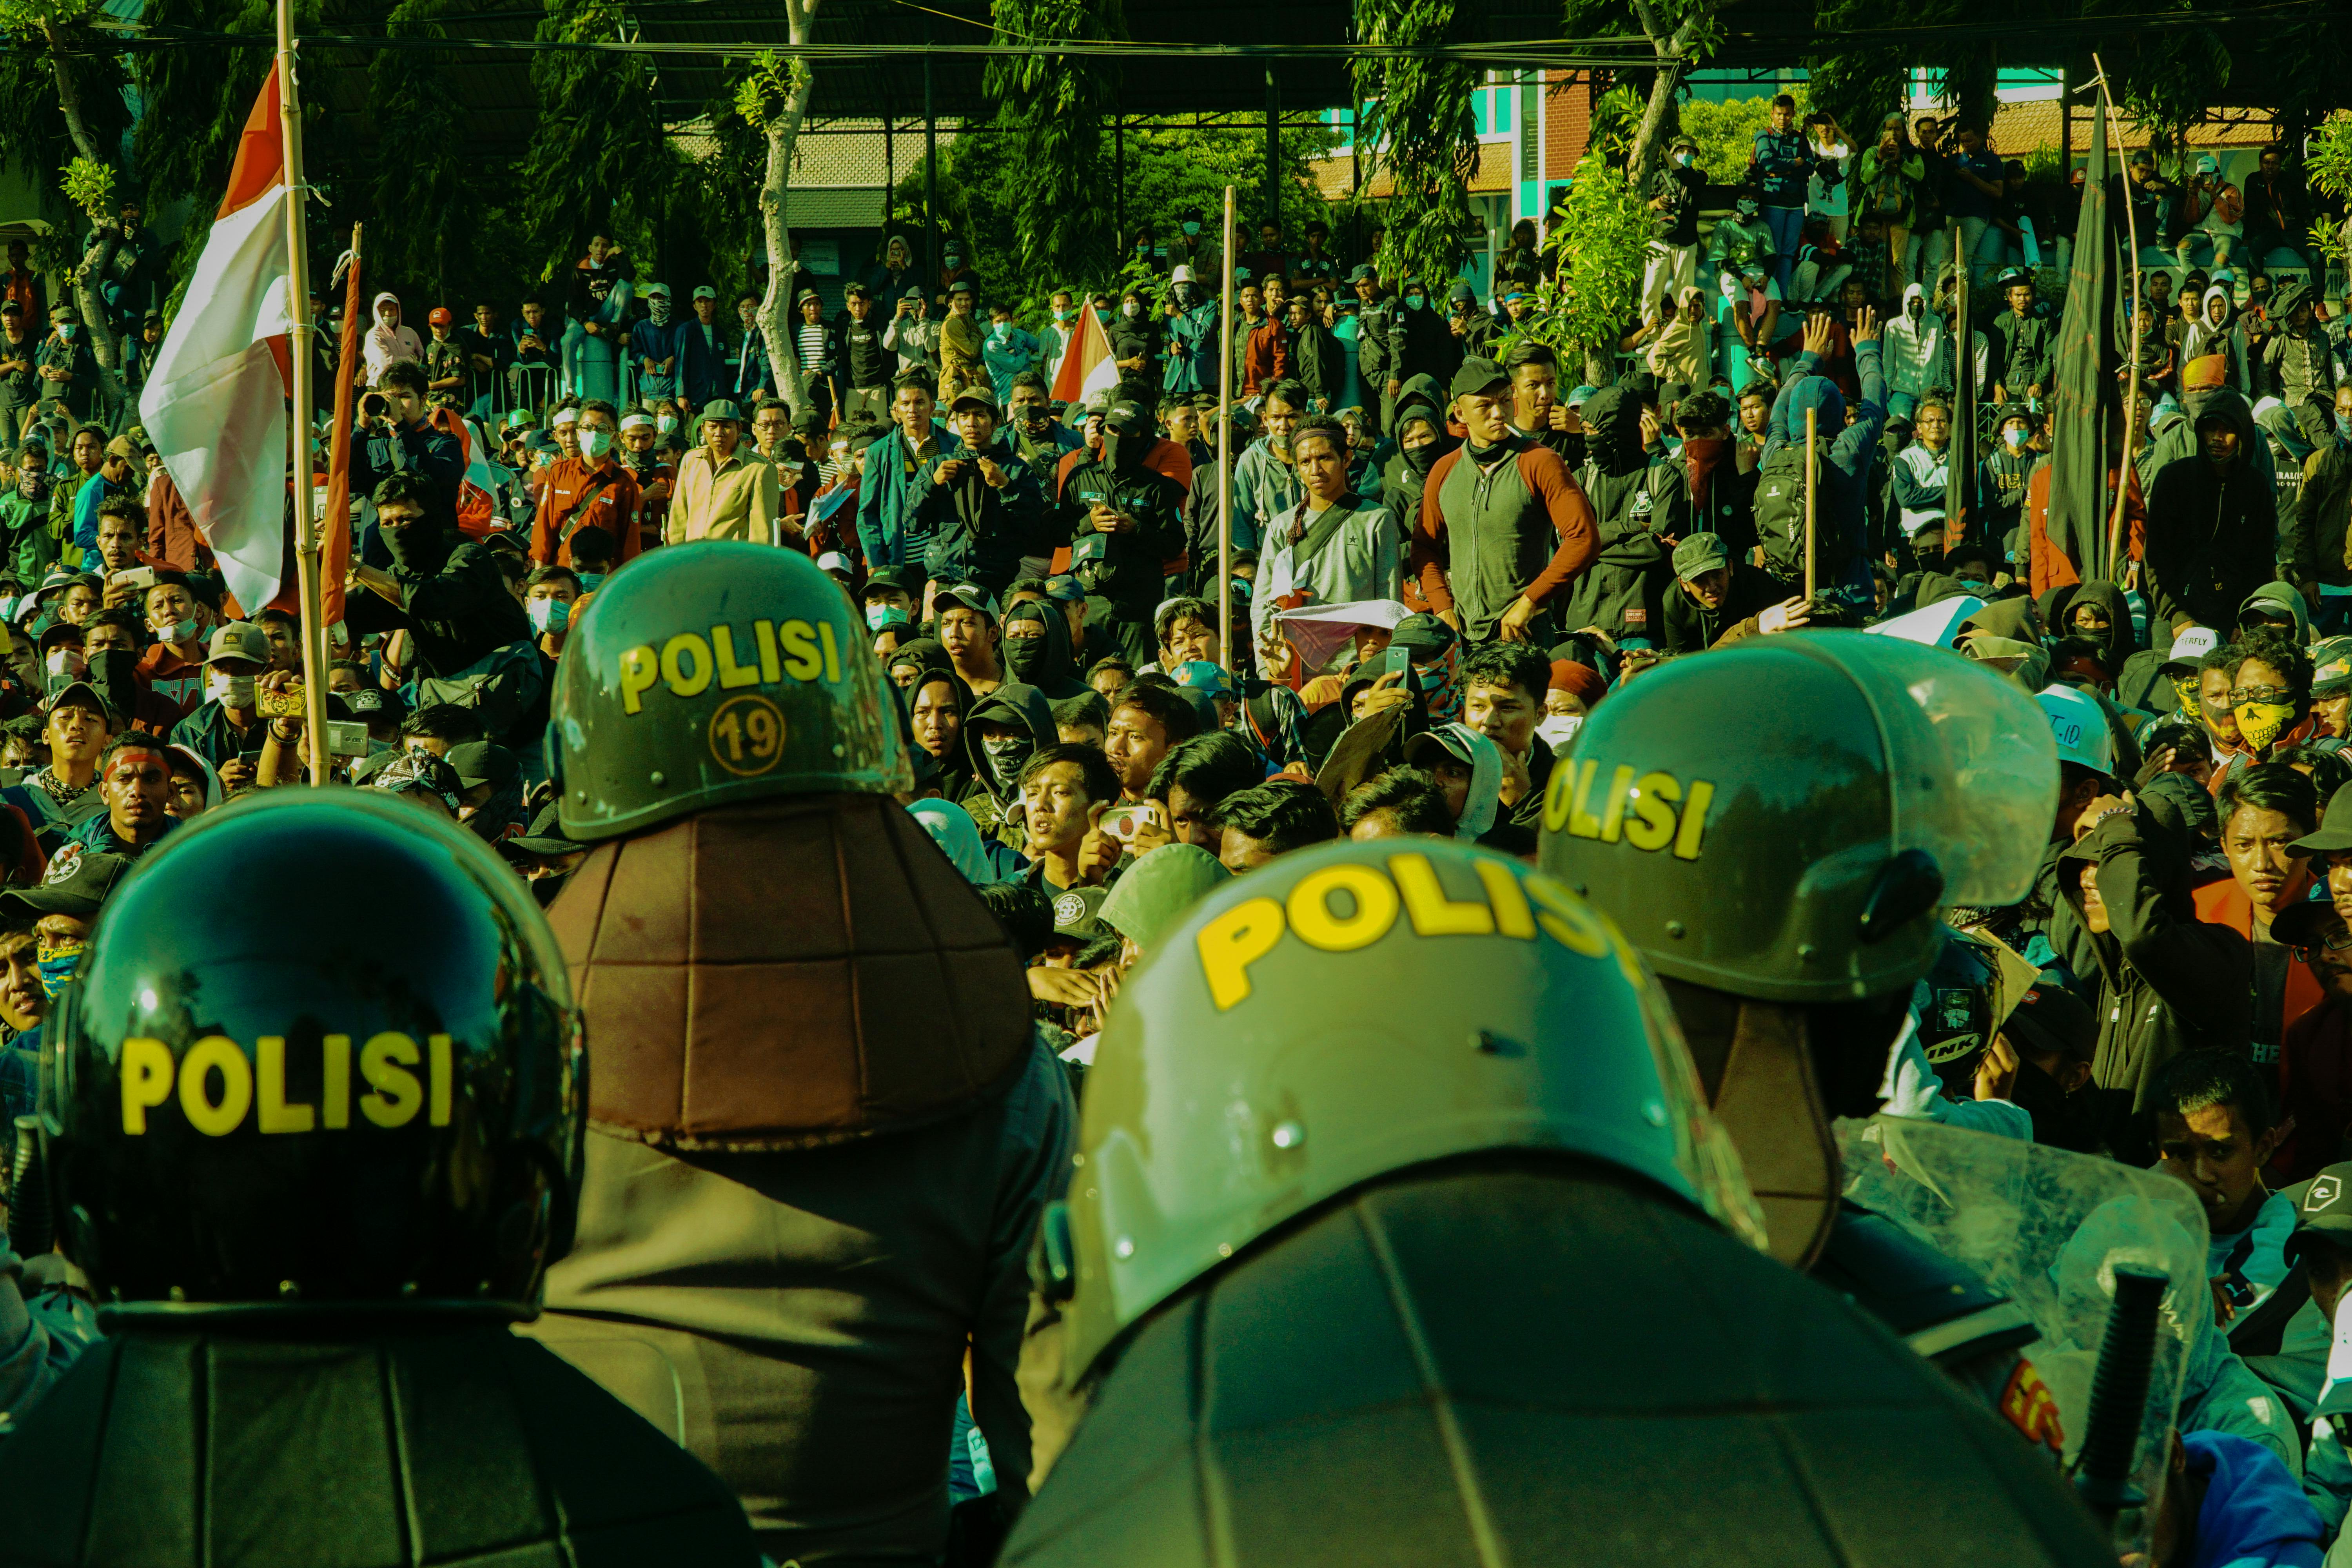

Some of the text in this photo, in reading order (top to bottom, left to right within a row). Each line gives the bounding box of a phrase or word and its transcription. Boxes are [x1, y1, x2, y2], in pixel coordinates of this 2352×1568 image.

[383, 664, 401, 681] Canon
[619, 619, 841, 715] POLISI
[717, 708, 778, 761] 19
[1927, 1037, 1975, 1059] INK
[121, 1031, 453, 1136] POLISI
